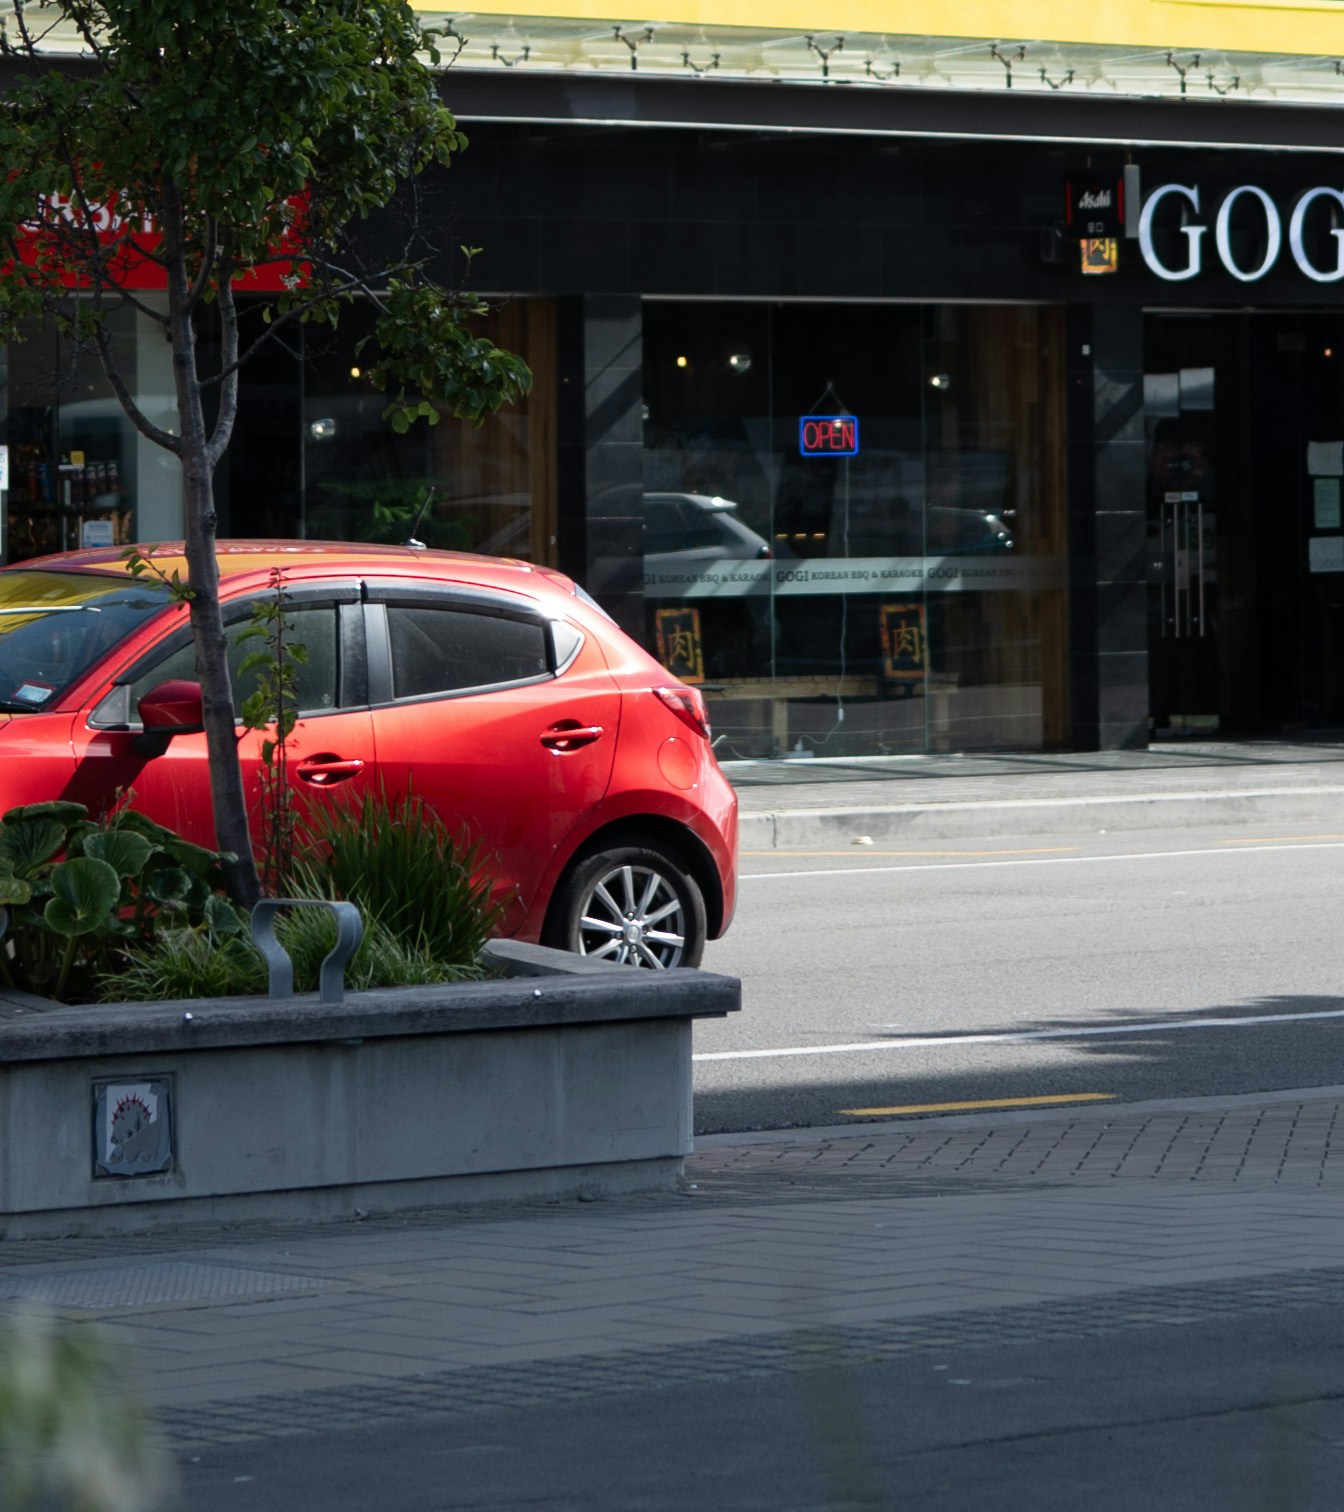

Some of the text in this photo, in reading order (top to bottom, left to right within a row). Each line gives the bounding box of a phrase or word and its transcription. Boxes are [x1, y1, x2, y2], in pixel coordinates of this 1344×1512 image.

[1078, 189, 1111, 209] Asahi
[803, 421, 855, 449] OPEN
[659, 574, 697, 583] KOREAN
[700, 573, 720, 584] BBQ
[776, 570, 809, 582] GOGI
[811, 571, 849, 581] KOREAN
[851, 570, 870, 582] BBQ
[880, 569, 923, 579] KARAOKE
[928, 567, 960, 578] GOGI
